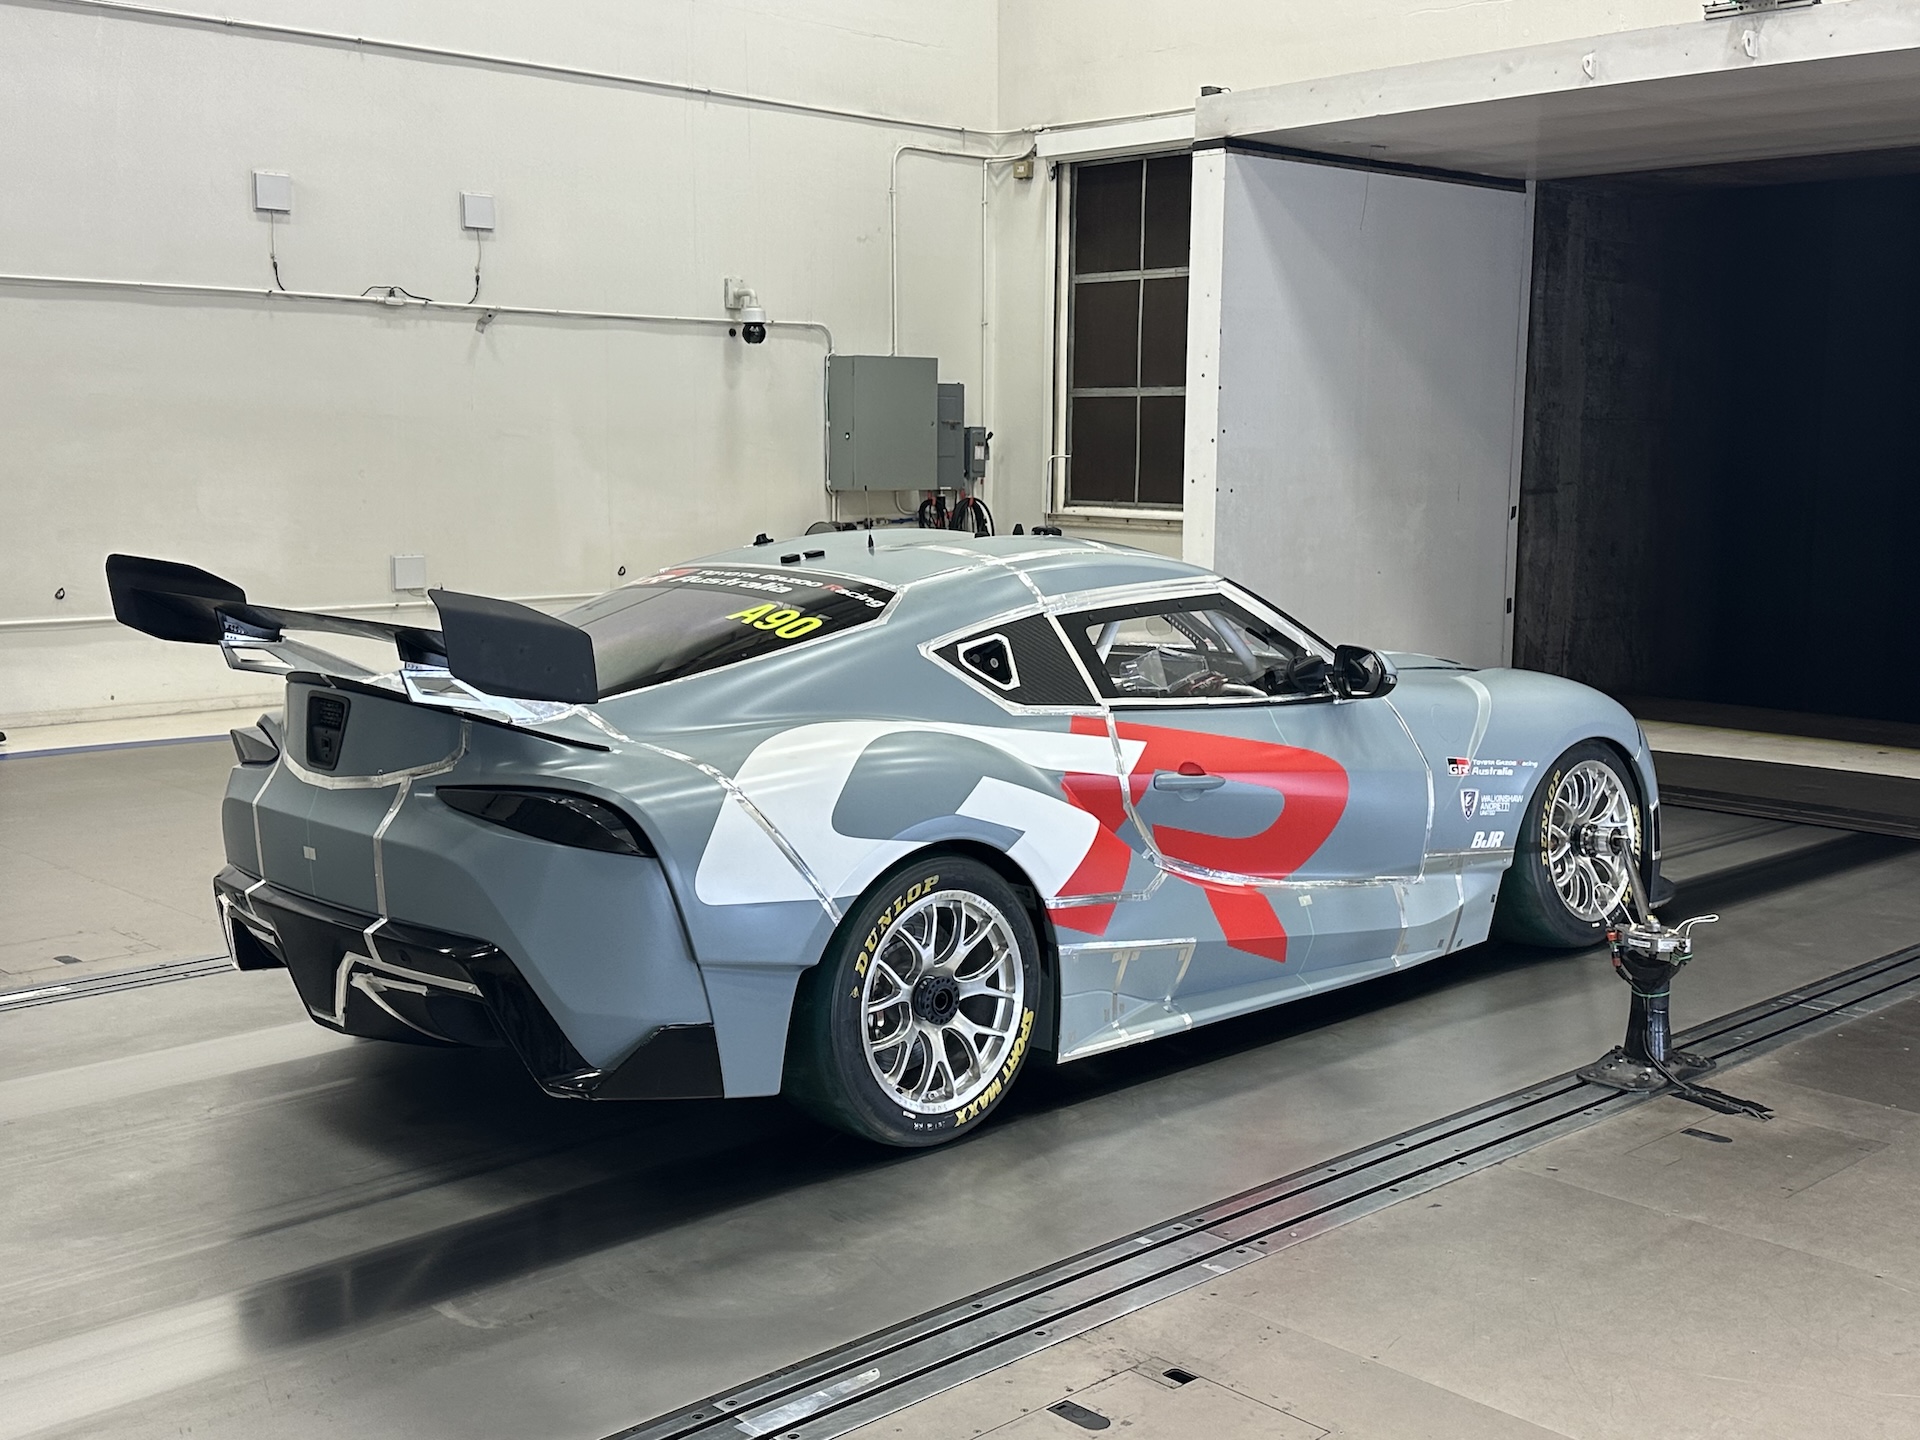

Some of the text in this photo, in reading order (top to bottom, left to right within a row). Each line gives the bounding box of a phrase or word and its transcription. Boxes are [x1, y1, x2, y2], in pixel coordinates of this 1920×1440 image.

[668, 575, 793, 594] Australia
[821, 583, 886, 608] Racing
[725, 602, 823, 639] A90
[1471, 766, 1514, 776] Australia
[1541, 769, 1561, 867] DUNLOP
[1470, 831, 1505, 849] BJR
[855, 874, 940, 978] DUNLOP
[954, 1007, 1035, 1128] SPORT MAXX
